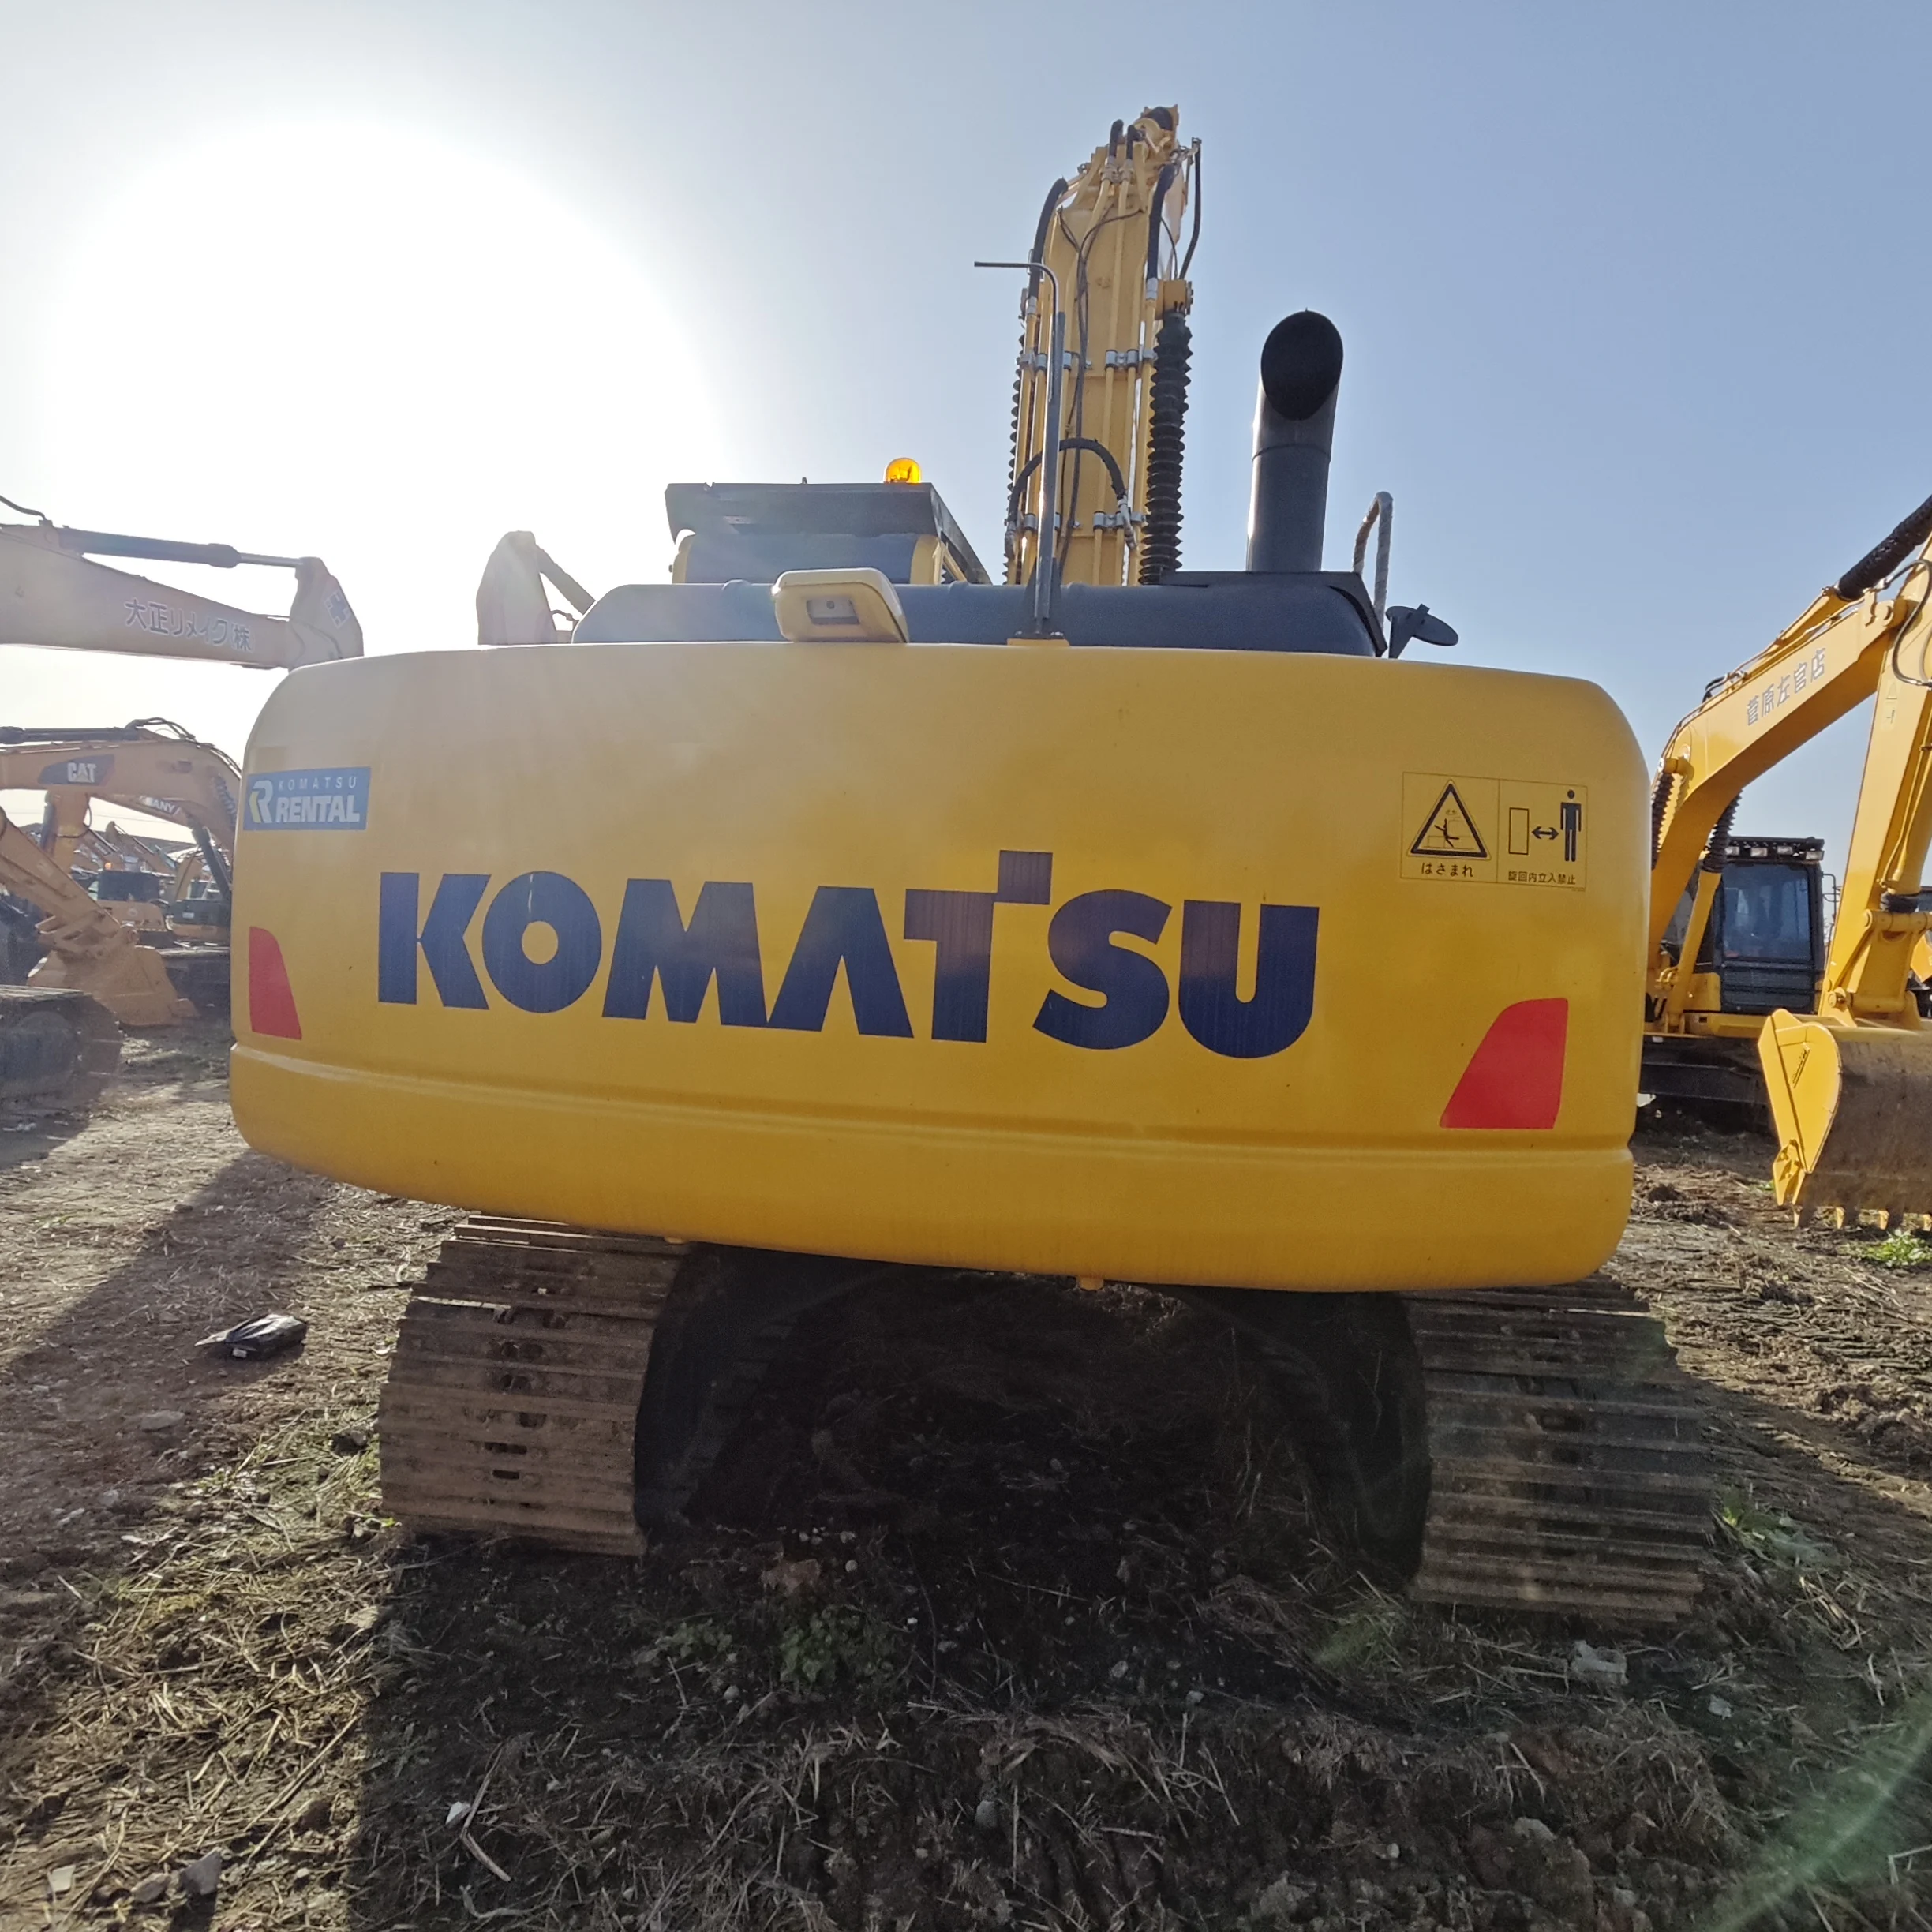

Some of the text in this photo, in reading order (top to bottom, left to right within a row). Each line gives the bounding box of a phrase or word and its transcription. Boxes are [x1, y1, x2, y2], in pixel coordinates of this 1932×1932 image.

[67, 762, 96, 783] CAT
[277, 776, 357, 791] KOMATSU
[275, 794, 361, 823] RENTAL
[1421, 862, 1473, 878] はさまれ
[1507, 871, 1576, 885] 旋回内立入禁止
[378, 848, 1320, 1059] KOMATSU
